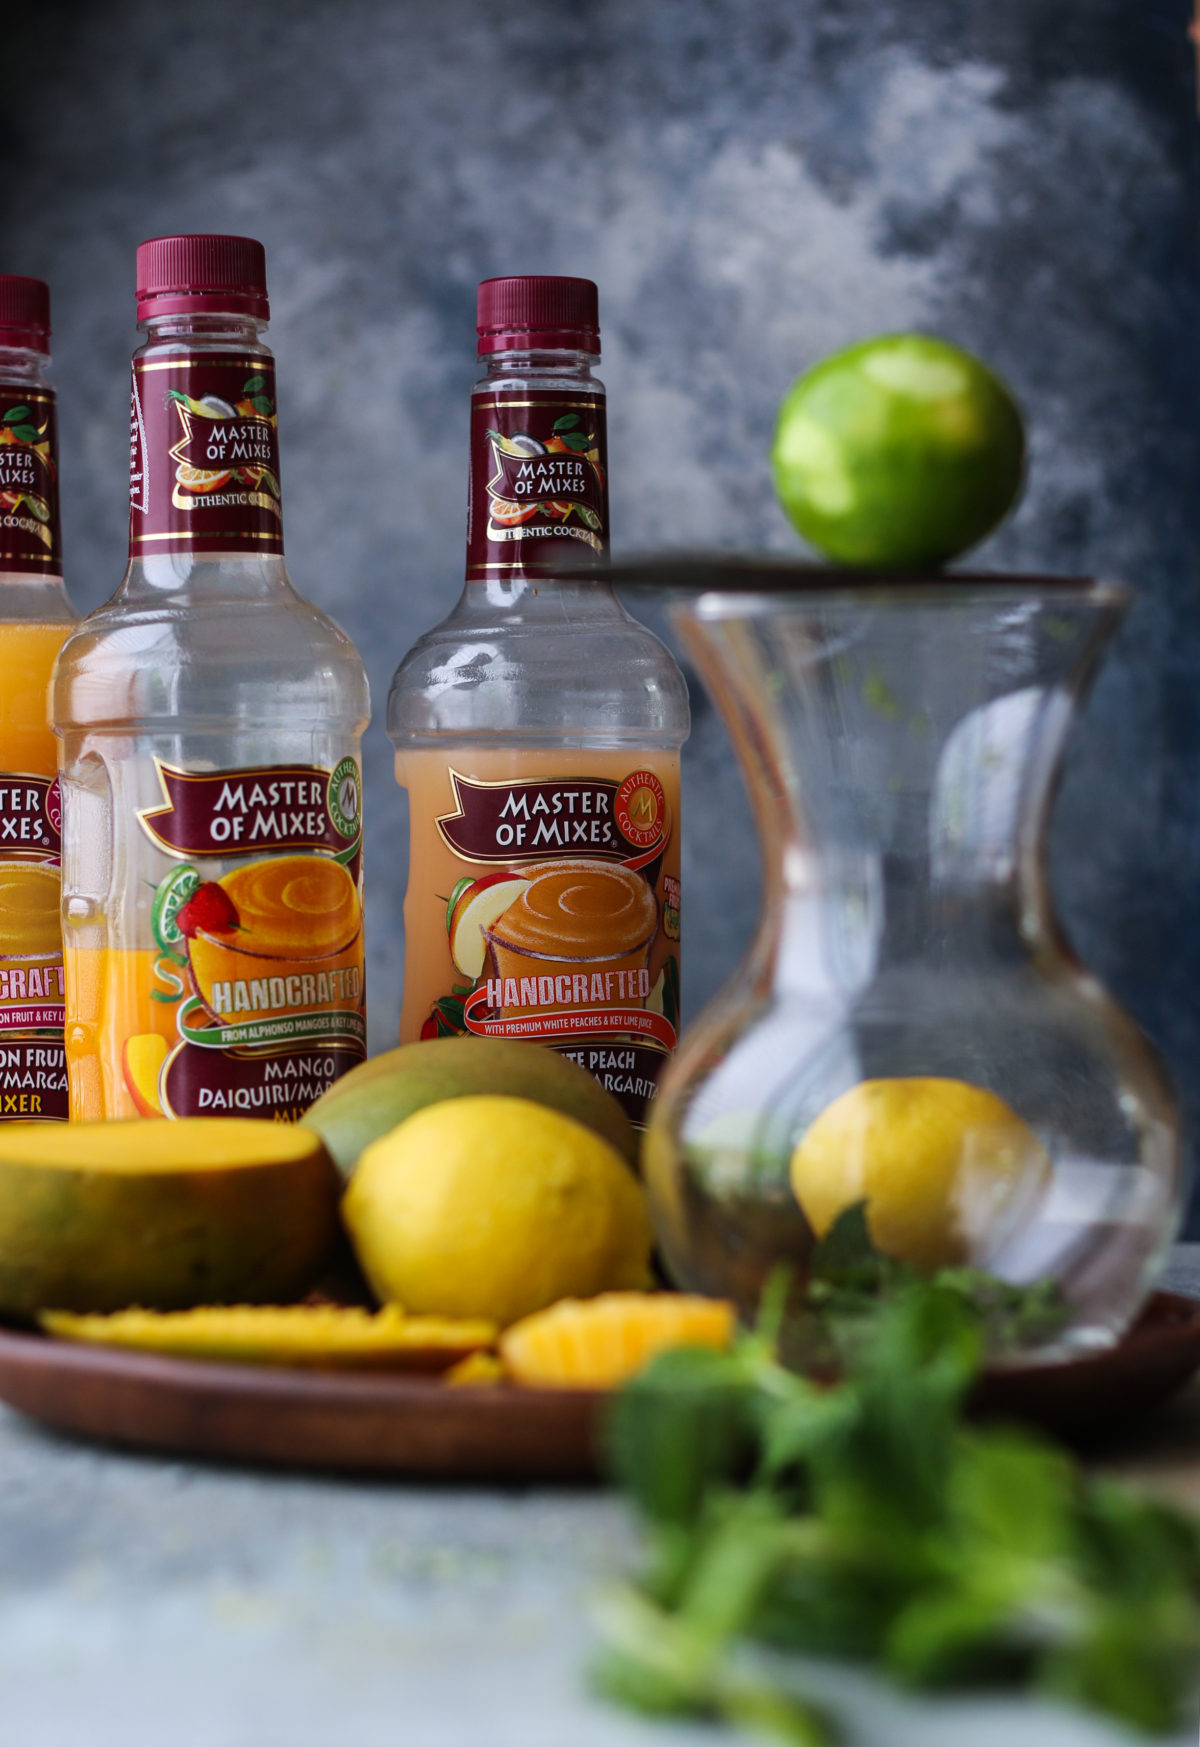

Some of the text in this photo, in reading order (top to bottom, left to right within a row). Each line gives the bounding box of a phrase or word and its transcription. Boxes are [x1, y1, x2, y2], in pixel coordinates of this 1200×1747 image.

[209, 426, 269, 443] MASTER
[206, 442, 271, 460] OF MIXES
[0, 469, 35, 484] IXES
[517, 462, 583, 479] MASTER
[515, 478, 585, 494] OF MIXES
[191, 493, 247, 508] UTHENTIC
[213, 781, 322, 813] MASTER
[620, 773, 665, 806] AUTHENTIC
[498, 790, 609, 821] MASTER
[210, 809, 325, 841] OF MIXES
[496, 817, 612, 846] OF MIXES
[618, 811, 662, 843] COCKTAILS
[212, 967, 360, 1014] HANDCRAFTED
[487, 969, 649, 1007] HANDCRAFTED
[11, 1012, 34, 1024] FRUIT
[36, 1013, 42, 1022] &
[43, 1012, 58, 1022] KEY
[221, 1029, 248, 1042] FROM
[249, 1023, 294, 1039] ALPHONSO
[294, 1017, 330, 1032] MANGOES
[484, 1015, 653, 1034] WITH PREMIUM WHITE PEACHES & KEY LIME JUICE
[264, 1058, 336, 1081] MANGO
[589, 1051, 636, 1070] PEACH
